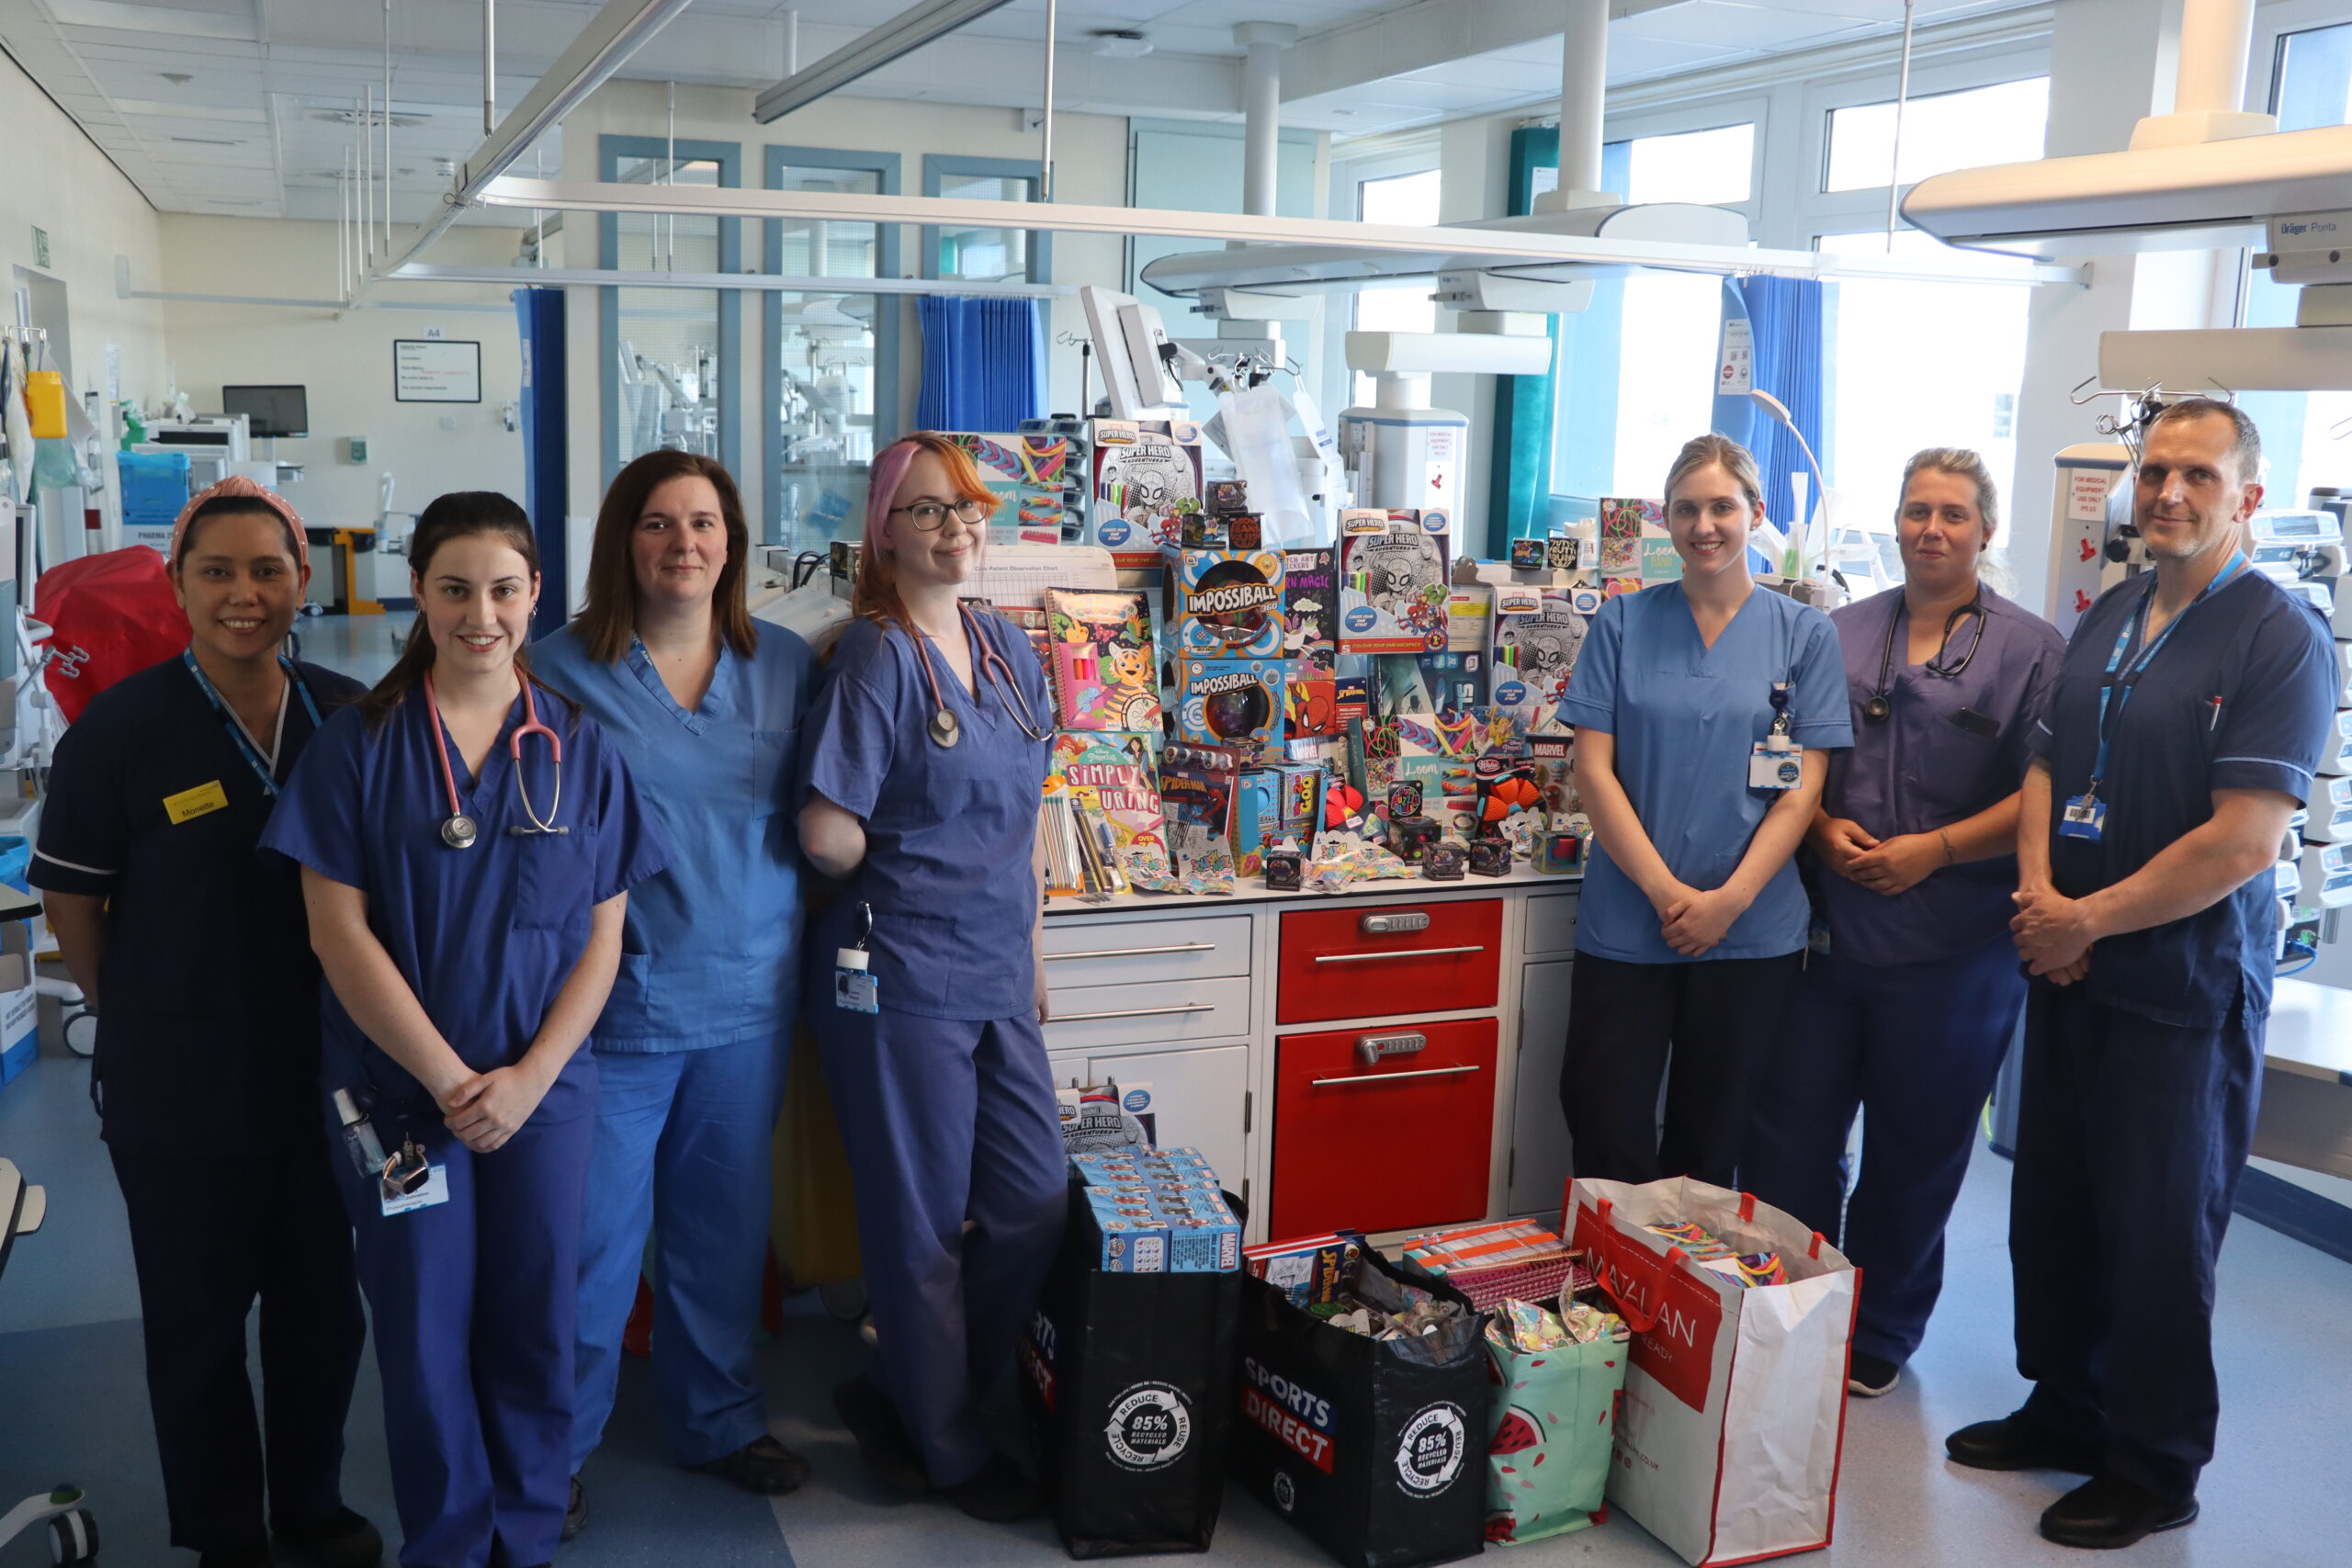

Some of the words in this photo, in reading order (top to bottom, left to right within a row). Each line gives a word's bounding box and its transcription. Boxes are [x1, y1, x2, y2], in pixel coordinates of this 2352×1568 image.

[2311, 222, 2337, 232] Ponta
[427, 329, 440, 337] A4
[1147, 446, 1171, 457] HERO
[1368, 534, 1395, 547] SUPER
[1396, 533, 1419, 544] HERO
[1300, 574, 1329, 588] MAGIC
[1189, 585, 1277, 613] IMPOSSIBALL
[1546, 612, 1568, 623] HERO
[1191, 674, 1258, 695] IMPOSSIBALL
[1534, 743, 1565, 757] MARVEL
[1405, 761, 1439, 776] Loom
[182, 801, 215, 818] Monette
[1094, 1116, 1122, 1129] HERO
[1221, 1233, 1237, 1268] MARVEL
[1244, 1357, 1330, 1427] SPORTS
[1120, 1394, 1159, 1416] REDUCE
[1131, 1414, 1169, 1432] 85%
[1178, 1416, 1188, 1449] REUSE
[1246, 1390, 1329, 1462] DIRECT
[1408, 1414, 1439, 1441] REDUCE
[1112, 1433, 1145, 1463] RECYCLE
[1418, 1430, 1447, 1454] 85%
[1402, 1461, 1430, 1485] RECYCLE
